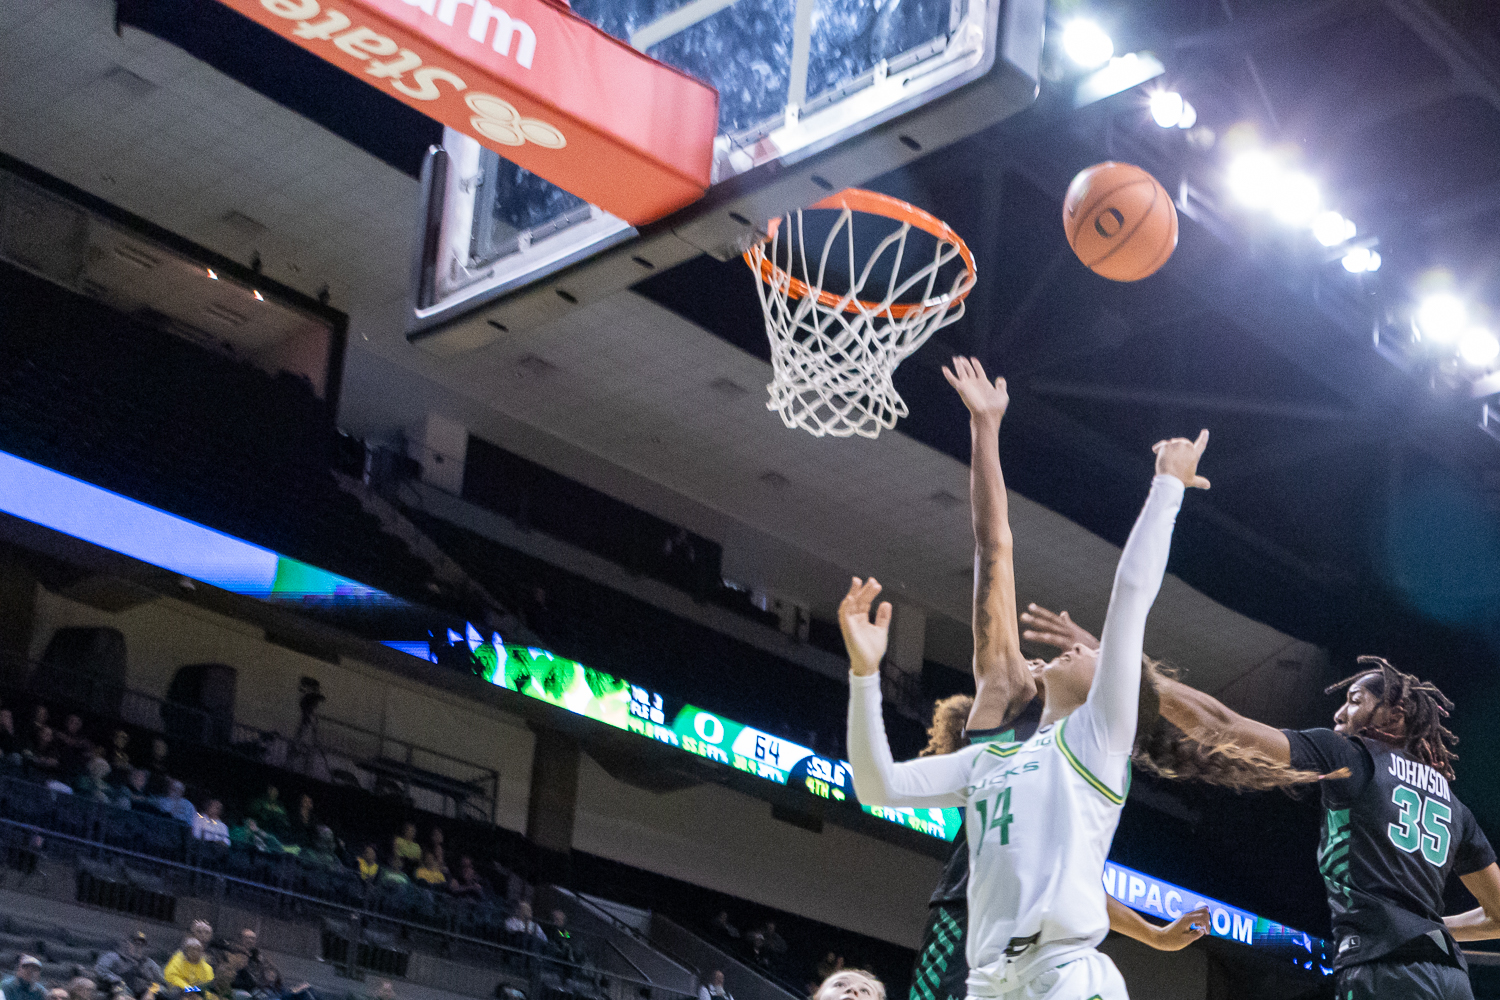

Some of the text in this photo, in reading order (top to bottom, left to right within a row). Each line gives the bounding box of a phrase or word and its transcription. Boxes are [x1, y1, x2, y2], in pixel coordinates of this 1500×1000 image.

[260, 0, 467, 101] State
[694, 712, 724, 745] O
[754, 735, 780, 766] 64
[805, 776, 830, 799] 4TH
[1388, 753, 1451, 802] JOHNSON
[976, 787, 1014, 855] 14
[1388, 784, 1451, 868] 35
